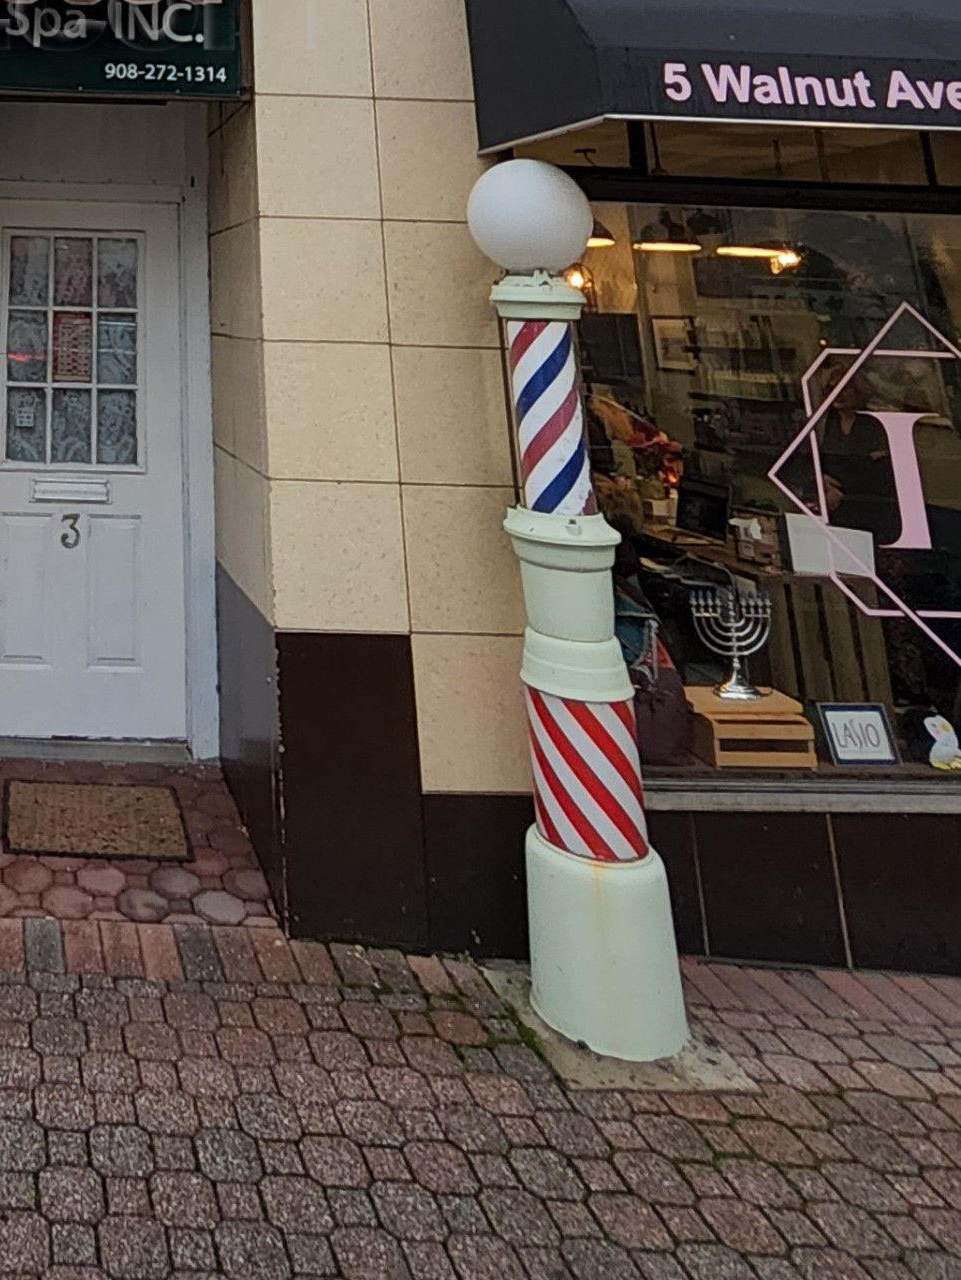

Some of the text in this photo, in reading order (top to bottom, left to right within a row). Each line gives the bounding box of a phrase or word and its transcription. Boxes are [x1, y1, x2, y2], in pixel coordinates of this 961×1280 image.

[5, 1, 86, 47] Spa
[113, 1, 205, 44] INC.
[104, 63, 227, 84] 908-272-1314
[663, 62, 693, 102] 5
[701, 64, 876, 108] Walnut
[60, 513, 82, 549] 3
